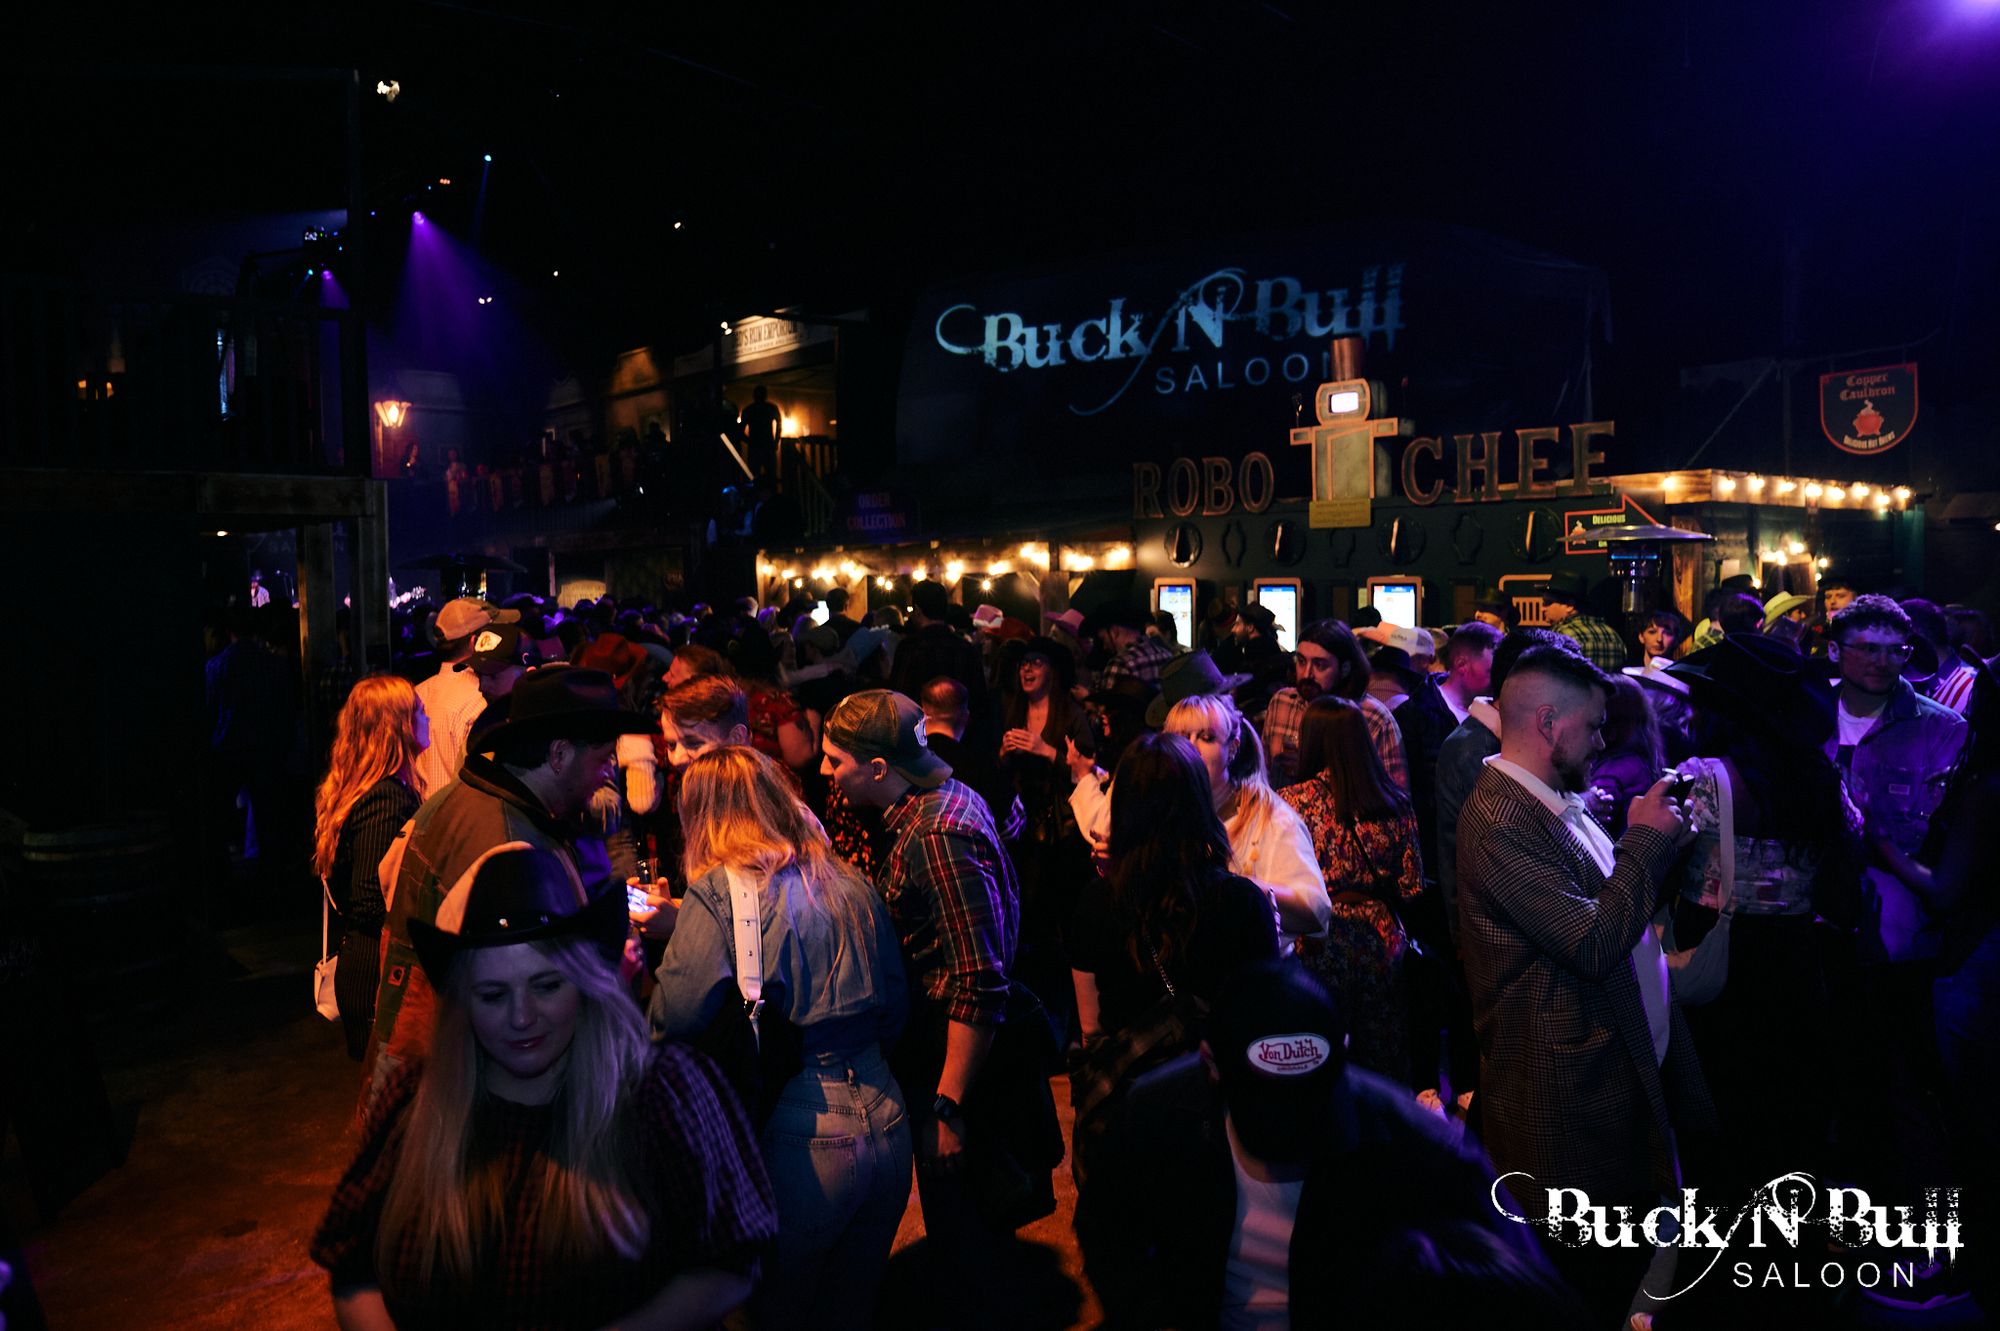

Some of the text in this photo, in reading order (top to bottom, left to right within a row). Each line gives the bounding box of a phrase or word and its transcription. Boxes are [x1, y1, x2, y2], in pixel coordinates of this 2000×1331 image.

[978, 263, 1407, 373] Buck N Bull
[764, 320, 798, 339] EMPORIU
[1846, 373, 1888, 386] Copper
[1840, 386, 1896, 401] Cauldron
[1131, 420, 1616, 519] ROBO CHEF
[858, 492, 892, 509] ORDER
[847, 512, 906, 531] COLLECTION
[1592, 514, 1626, 525] DELICIOUS
[1283, 1039, 1322, 1060] Dutch
